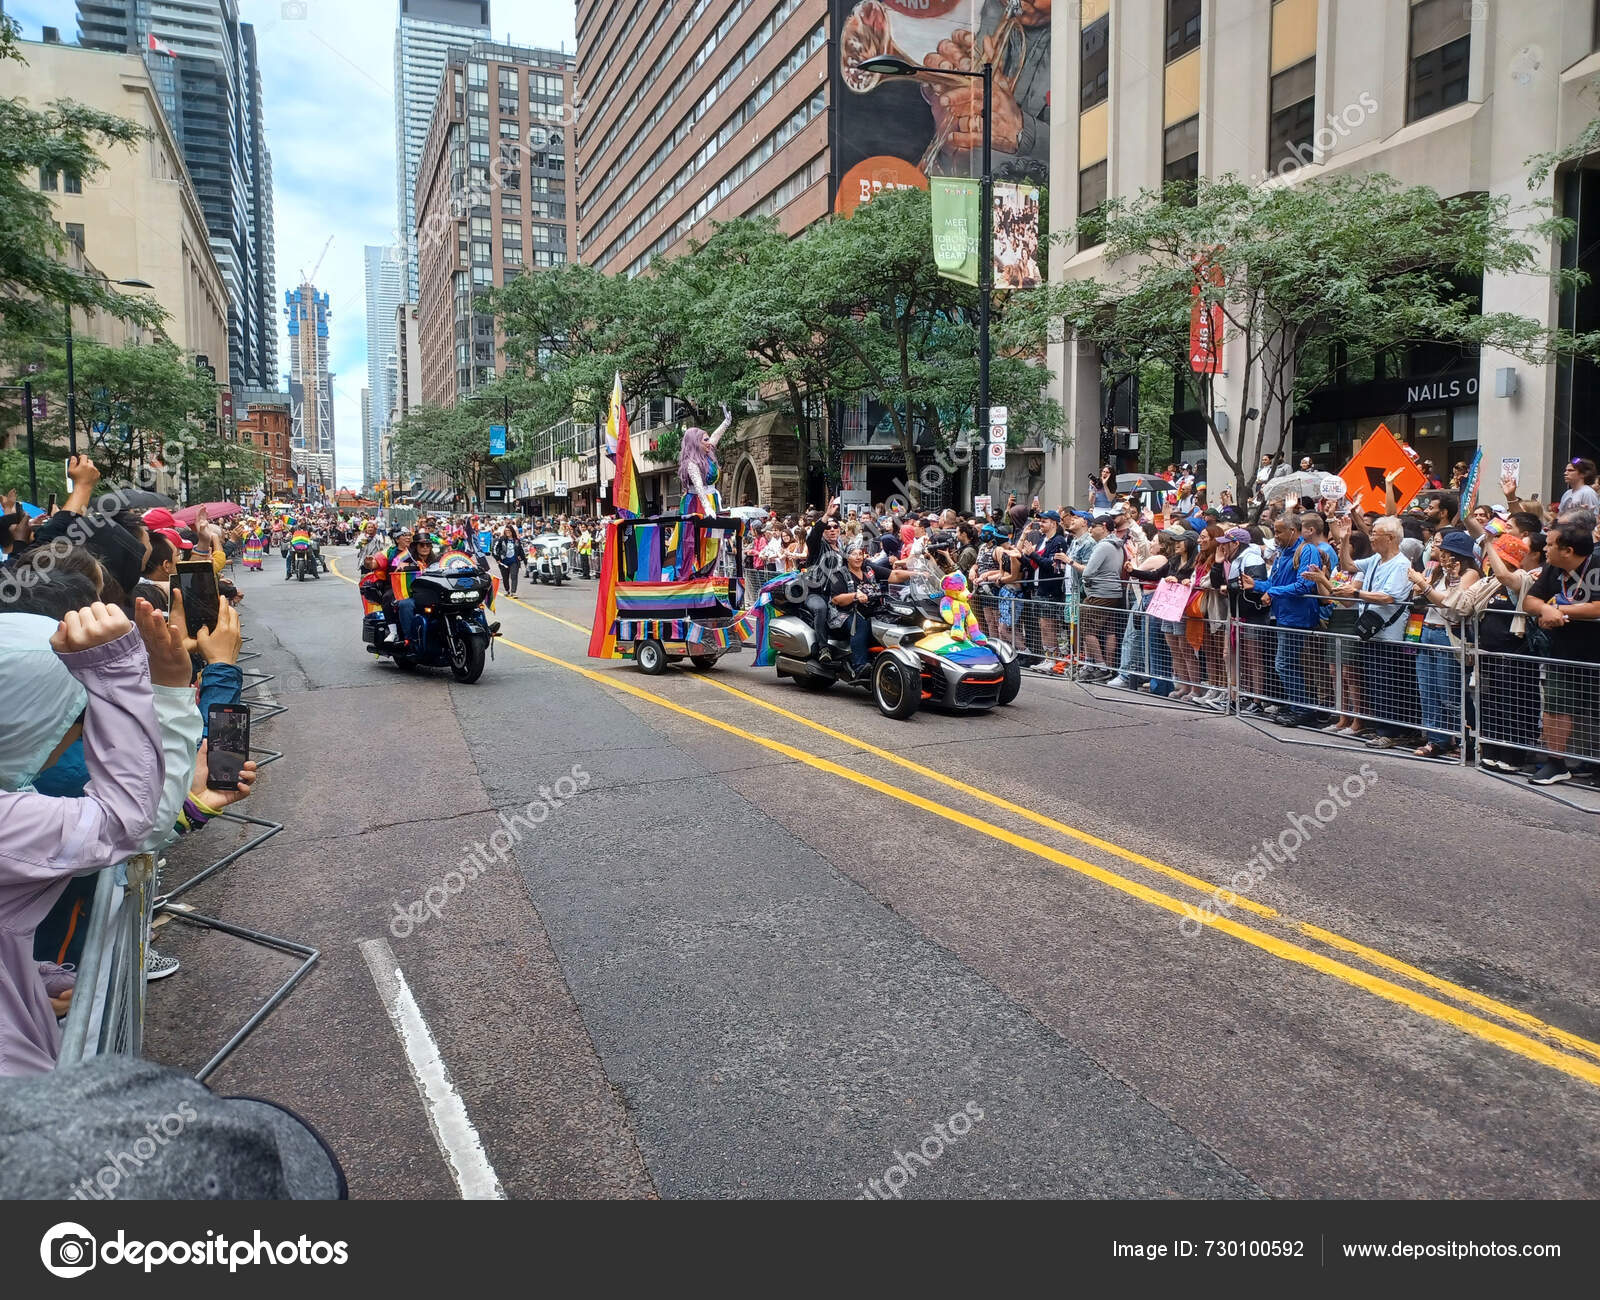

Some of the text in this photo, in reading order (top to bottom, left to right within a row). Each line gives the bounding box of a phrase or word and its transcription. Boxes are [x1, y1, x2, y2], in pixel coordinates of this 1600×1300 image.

[945, 218, 968, 227] MEET
[939, 251, 967, 260] HEART
[1407, 380, 1460, 402] NAILS
[556, 486, 566, 495] 40
